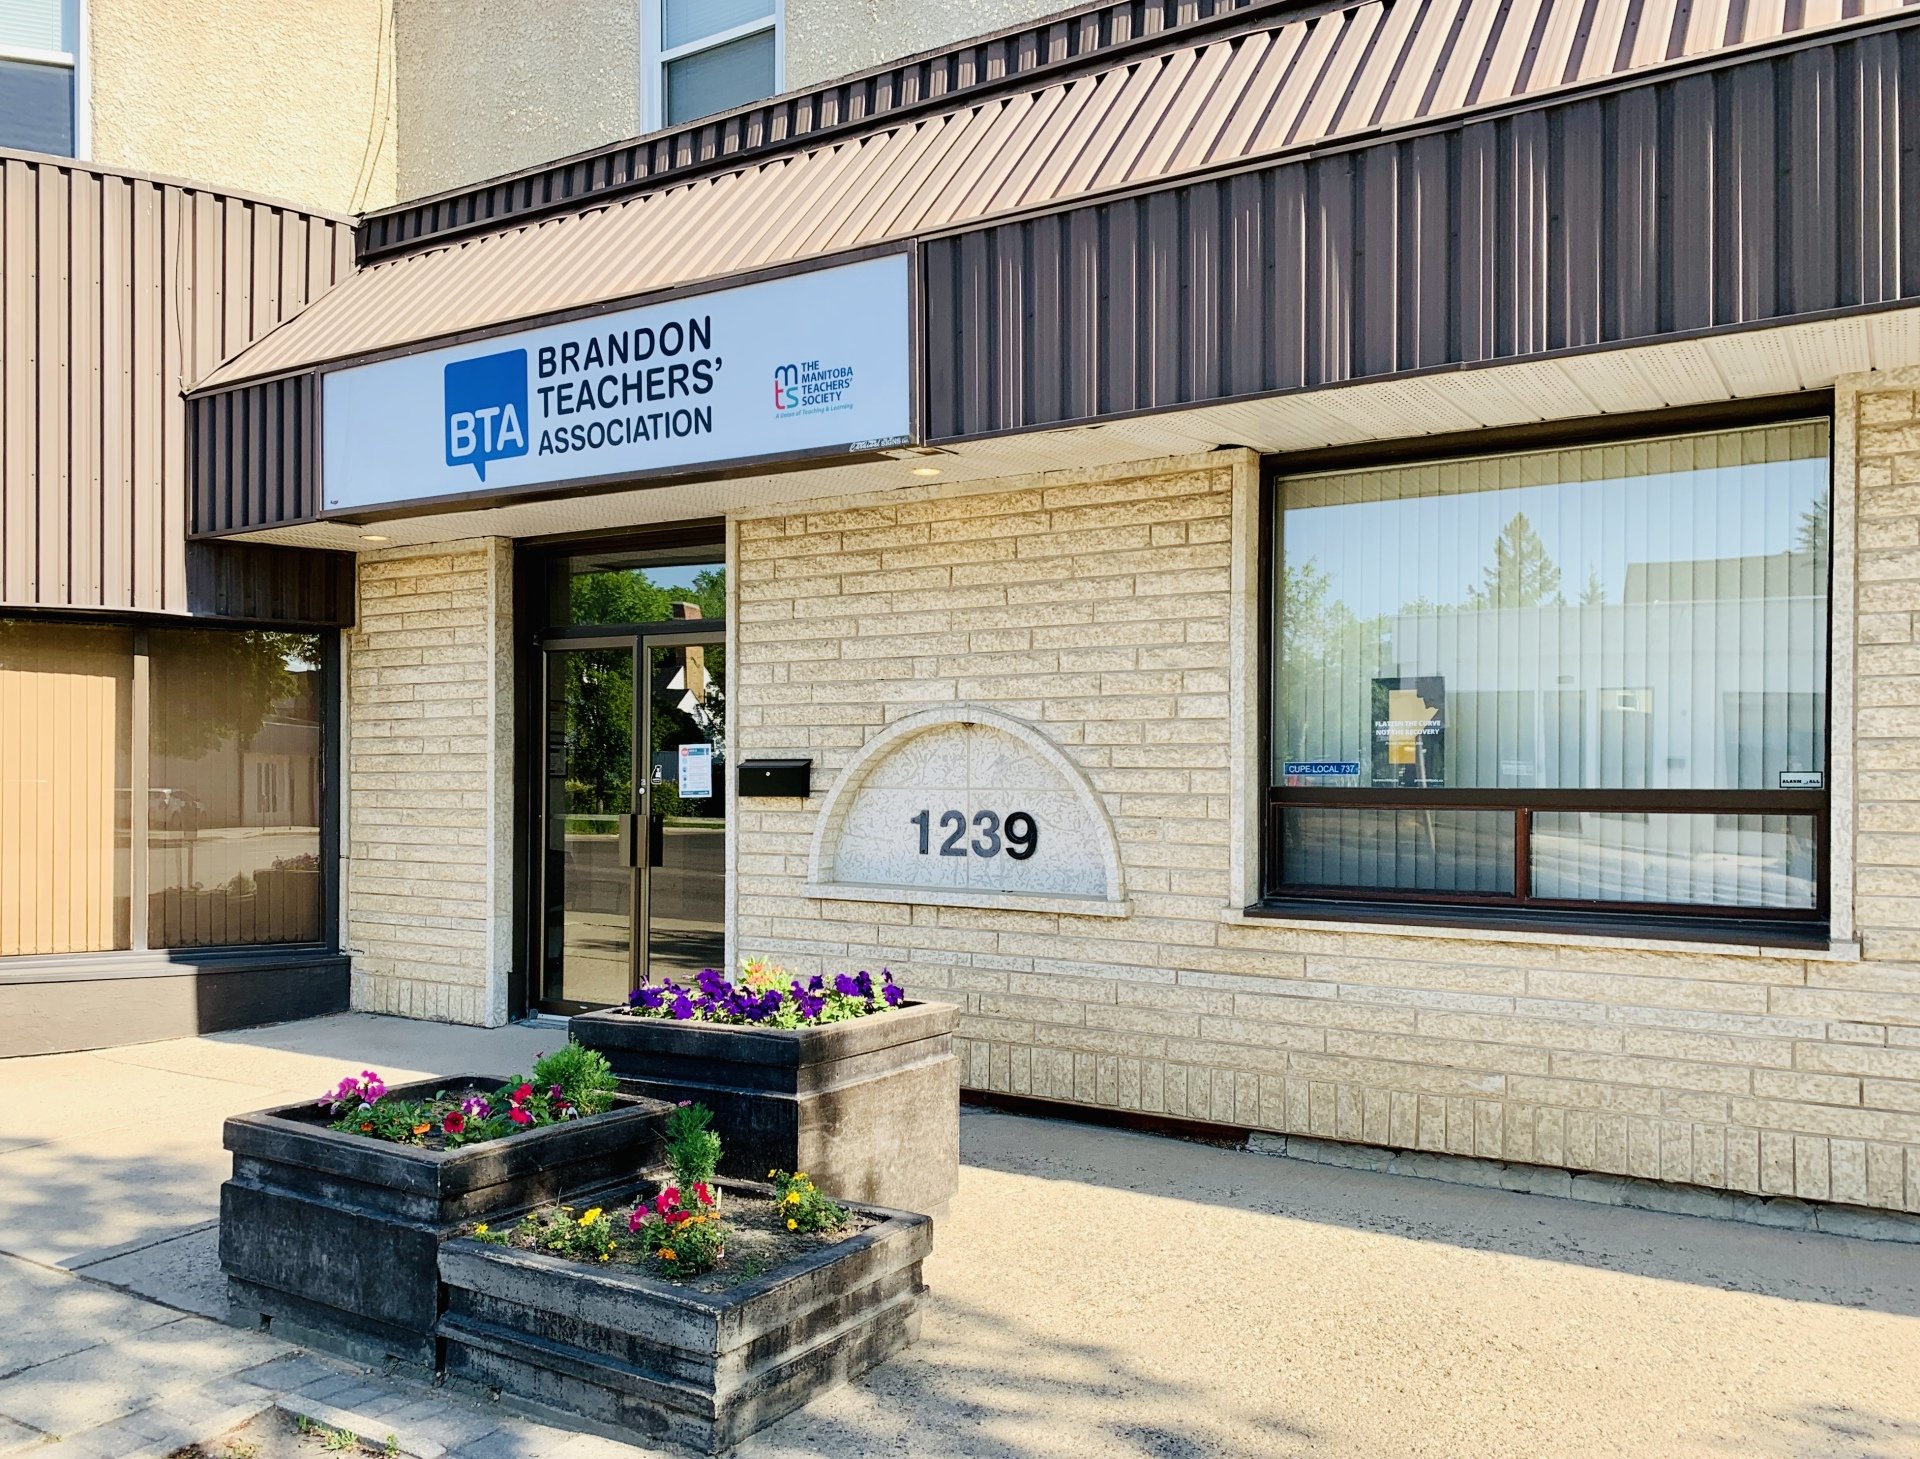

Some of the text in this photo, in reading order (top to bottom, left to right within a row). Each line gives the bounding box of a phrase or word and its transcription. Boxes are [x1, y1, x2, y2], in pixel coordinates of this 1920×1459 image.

[538, 315, 711, 378] BRANDON
[801, 360, 820, 372] THE
[801, 366, 854, 384] MANITOBA
[537, 356, 722, 418] TEACHERS'
[801, 377, 853, 395] TEACHERS'
[802, 391, 842, 406] SOCIETY
[450, 403, 524, 458] BTA
[538, 405, 712, 456] ASSOCIATION
[1288, 765, 1355, 773] CUPE LOCAL 737
[910, 809, 1038, 861] 1239
